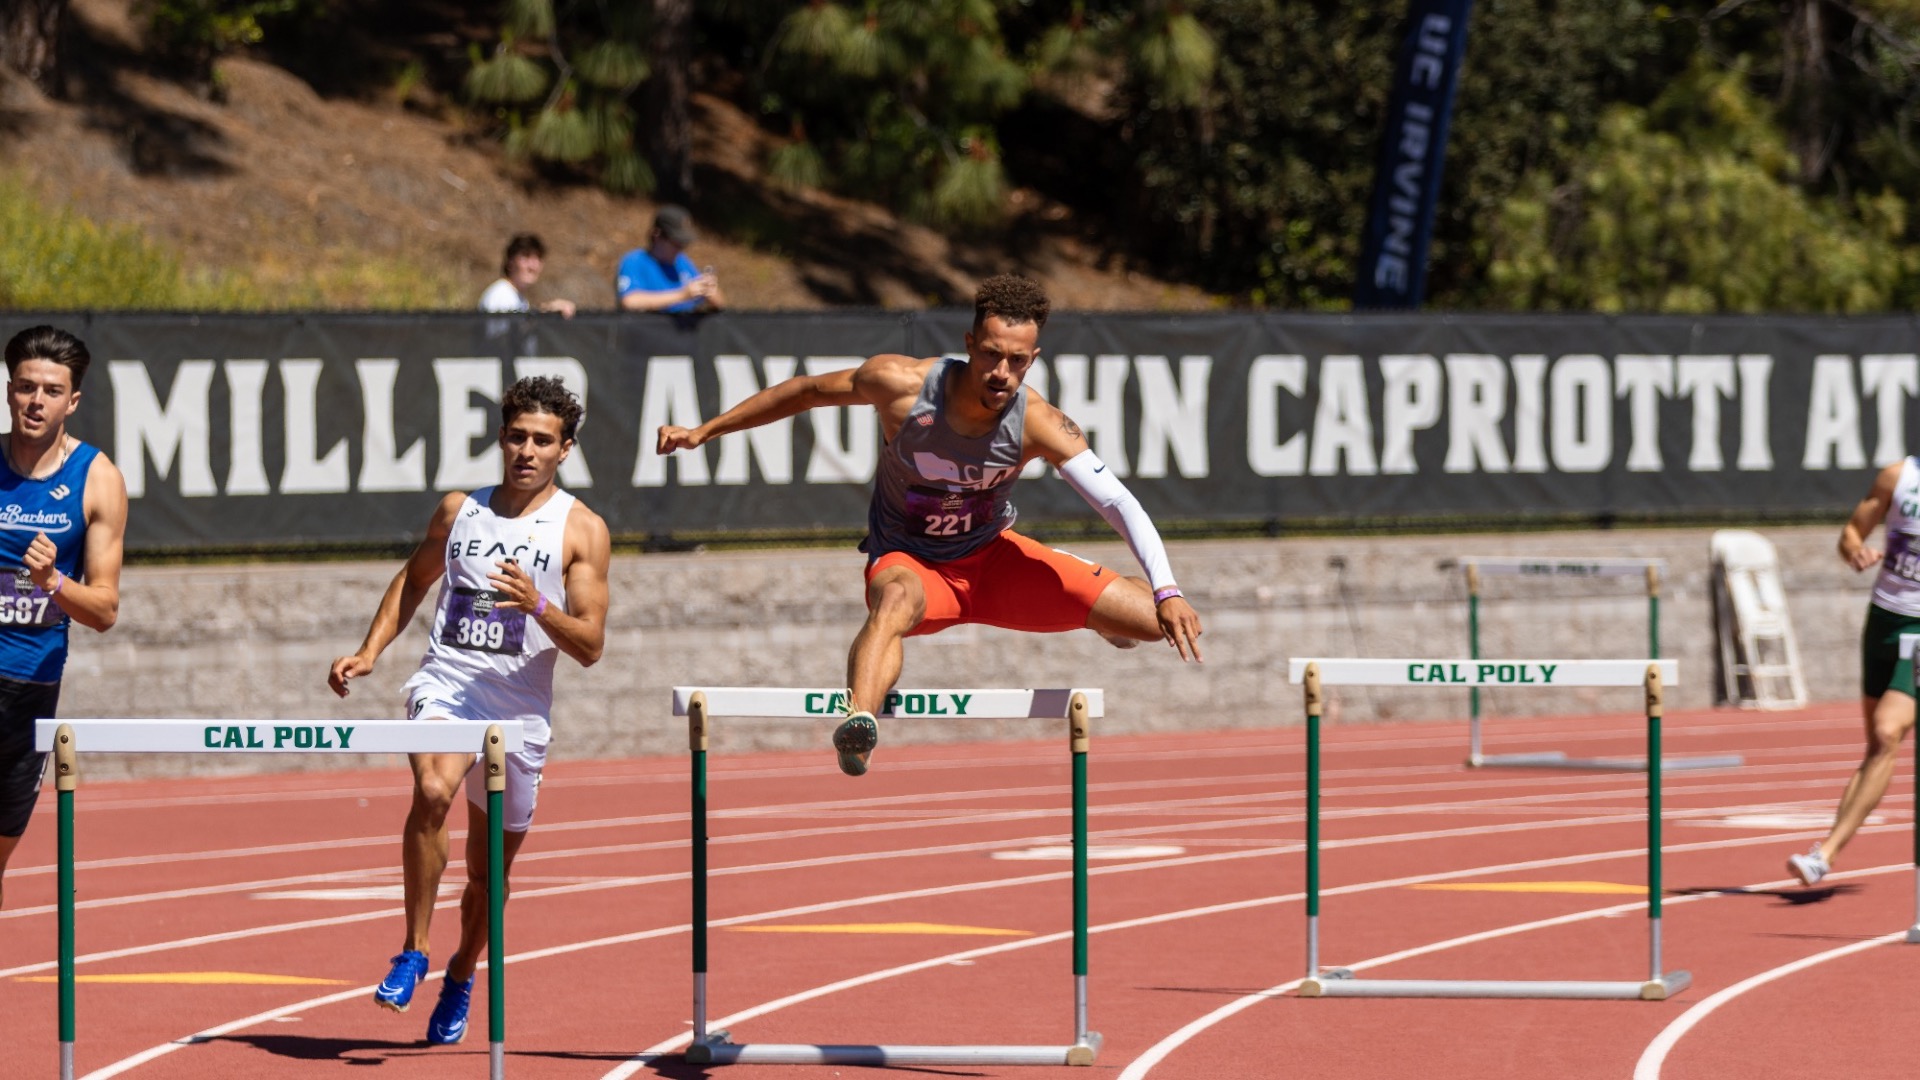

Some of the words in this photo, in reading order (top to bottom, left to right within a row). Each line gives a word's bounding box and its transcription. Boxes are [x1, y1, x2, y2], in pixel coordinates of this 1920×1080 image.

[1410, 12, 1451, 91] UC
[1375, 101, 1434, 294] IRVINE
[1247, 353, 1774, 477] CAPRIOTTI
[924, 512, 972, 537] 221
[451, 539, 551, 572] BEACH
[0, 595, 49, 625] 587
[456, 617, 504, 650] 389
[1408, 664, 1466, 683] CAL
[1477, 664, 1557, 683] POLY
[805, 692, 846, 714] CA
[882, 693, 972, 715] POLY
[204, 726, 264, 749] CAL
[273, 726, 355, 749] POLY
